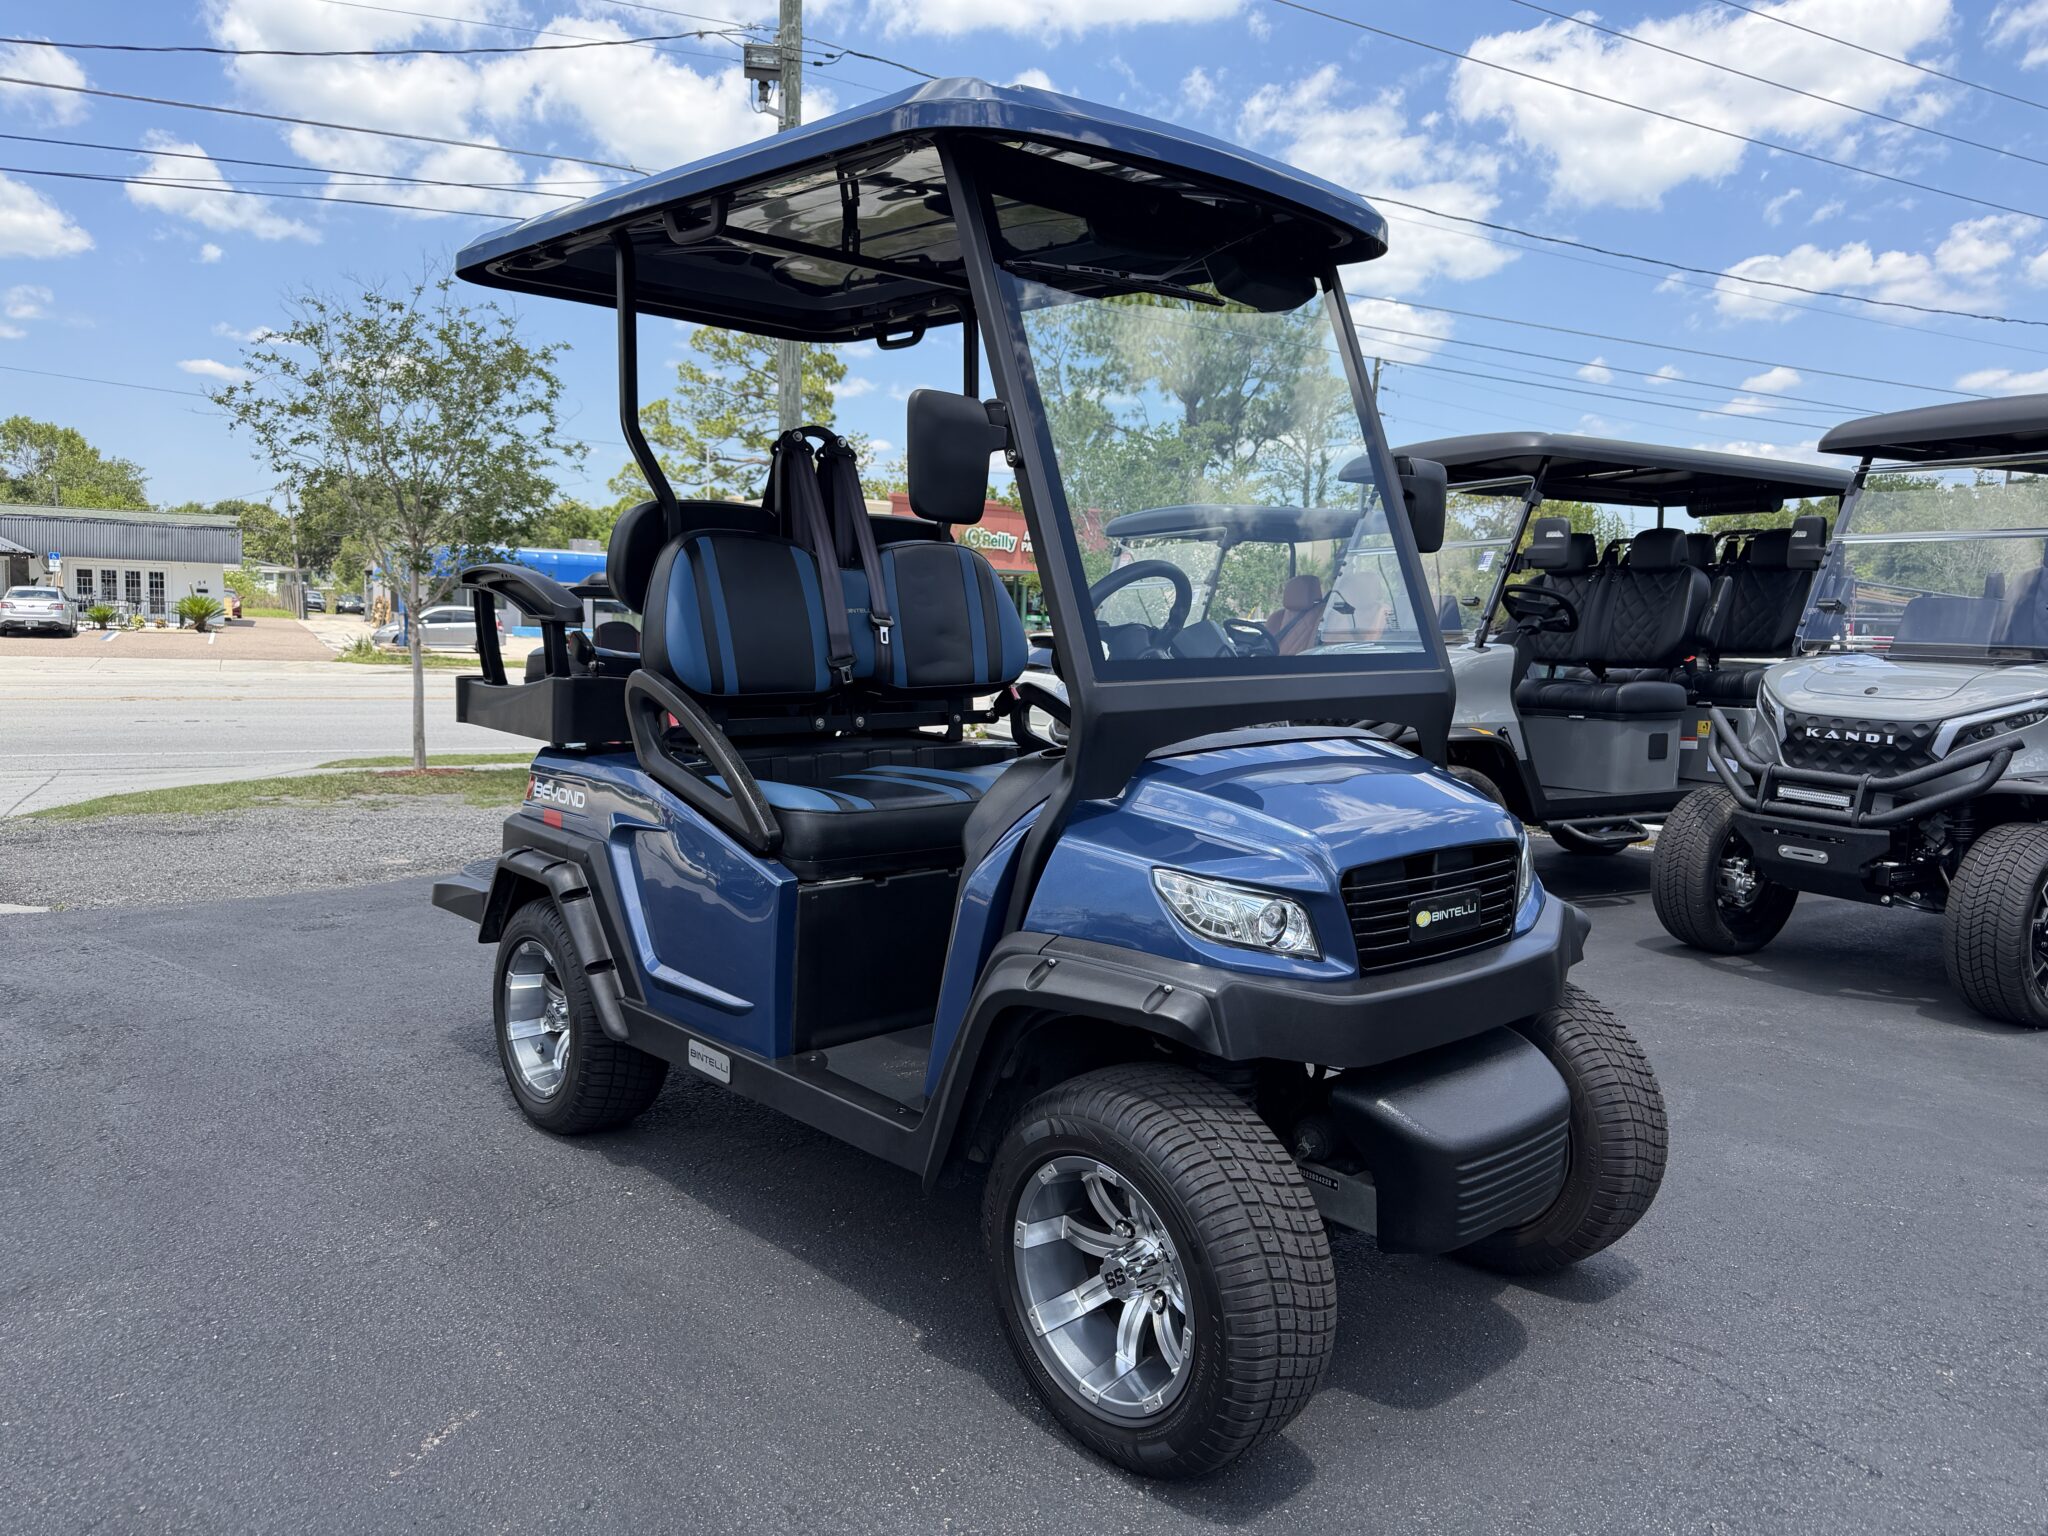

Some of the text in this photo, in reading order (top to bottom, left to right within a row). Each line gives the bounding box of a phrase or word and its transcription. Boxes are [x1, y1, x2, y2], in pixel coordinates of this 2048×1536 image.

[965, 527, 1018, 553] O'Reilly
[1806, 727, 1894, 745] KANDI
[534, 781, 585, 808] BEYOND
[1431, 902, 1477, 922] BINTELLI
[690, 1048, 729, 1074] BINTELLI
[1104, 1267, 1127, 1290] SS
